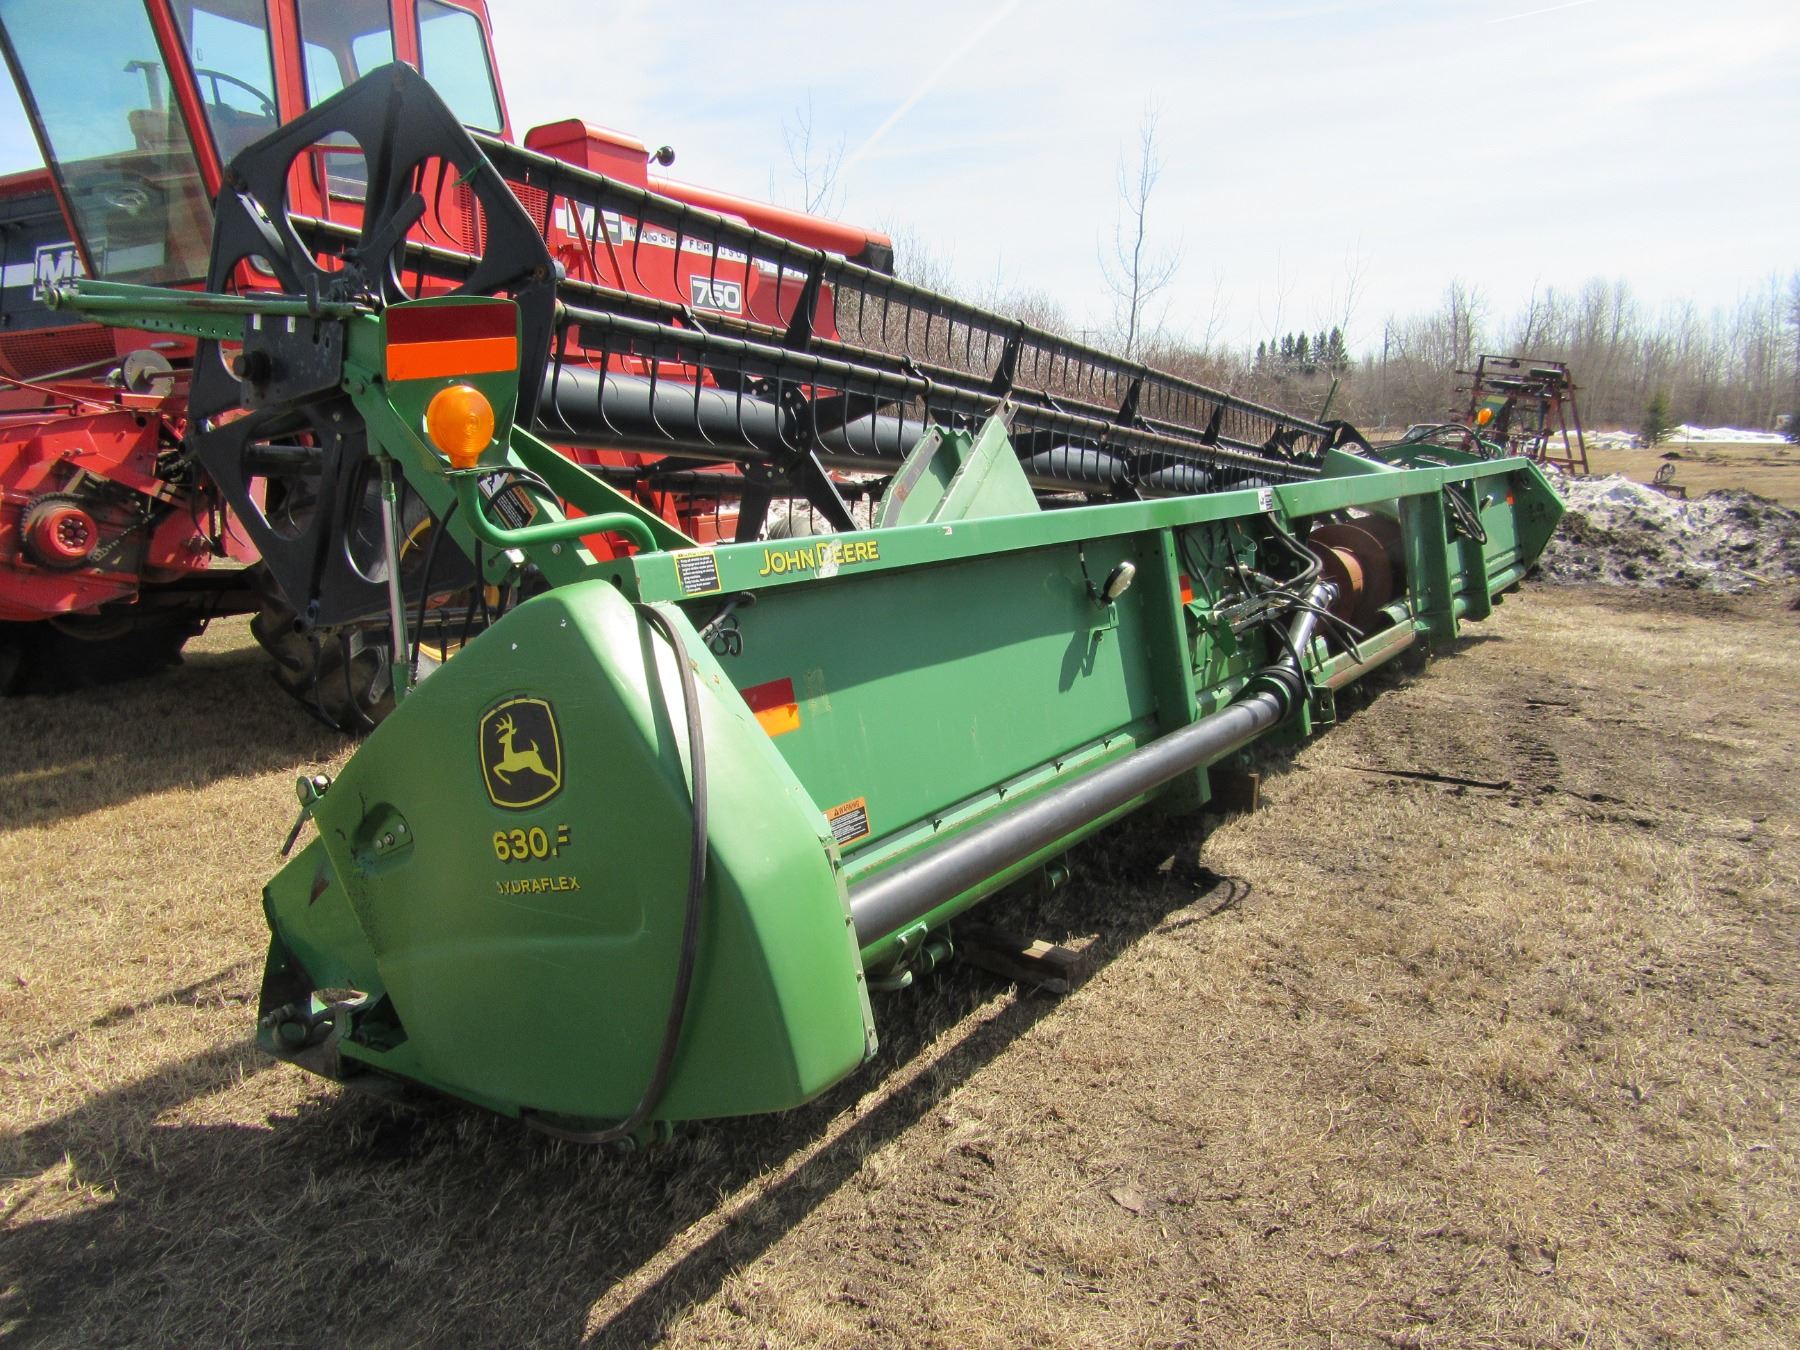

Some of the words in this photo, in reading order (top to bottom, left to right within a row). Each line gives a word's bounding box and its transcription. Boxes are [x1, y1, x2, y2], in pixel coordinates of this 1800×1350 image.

[692, 280, 740, 310] 750
[760, 549, 815, 575] JOHN
[816, 541, 880, 567] DEERE
